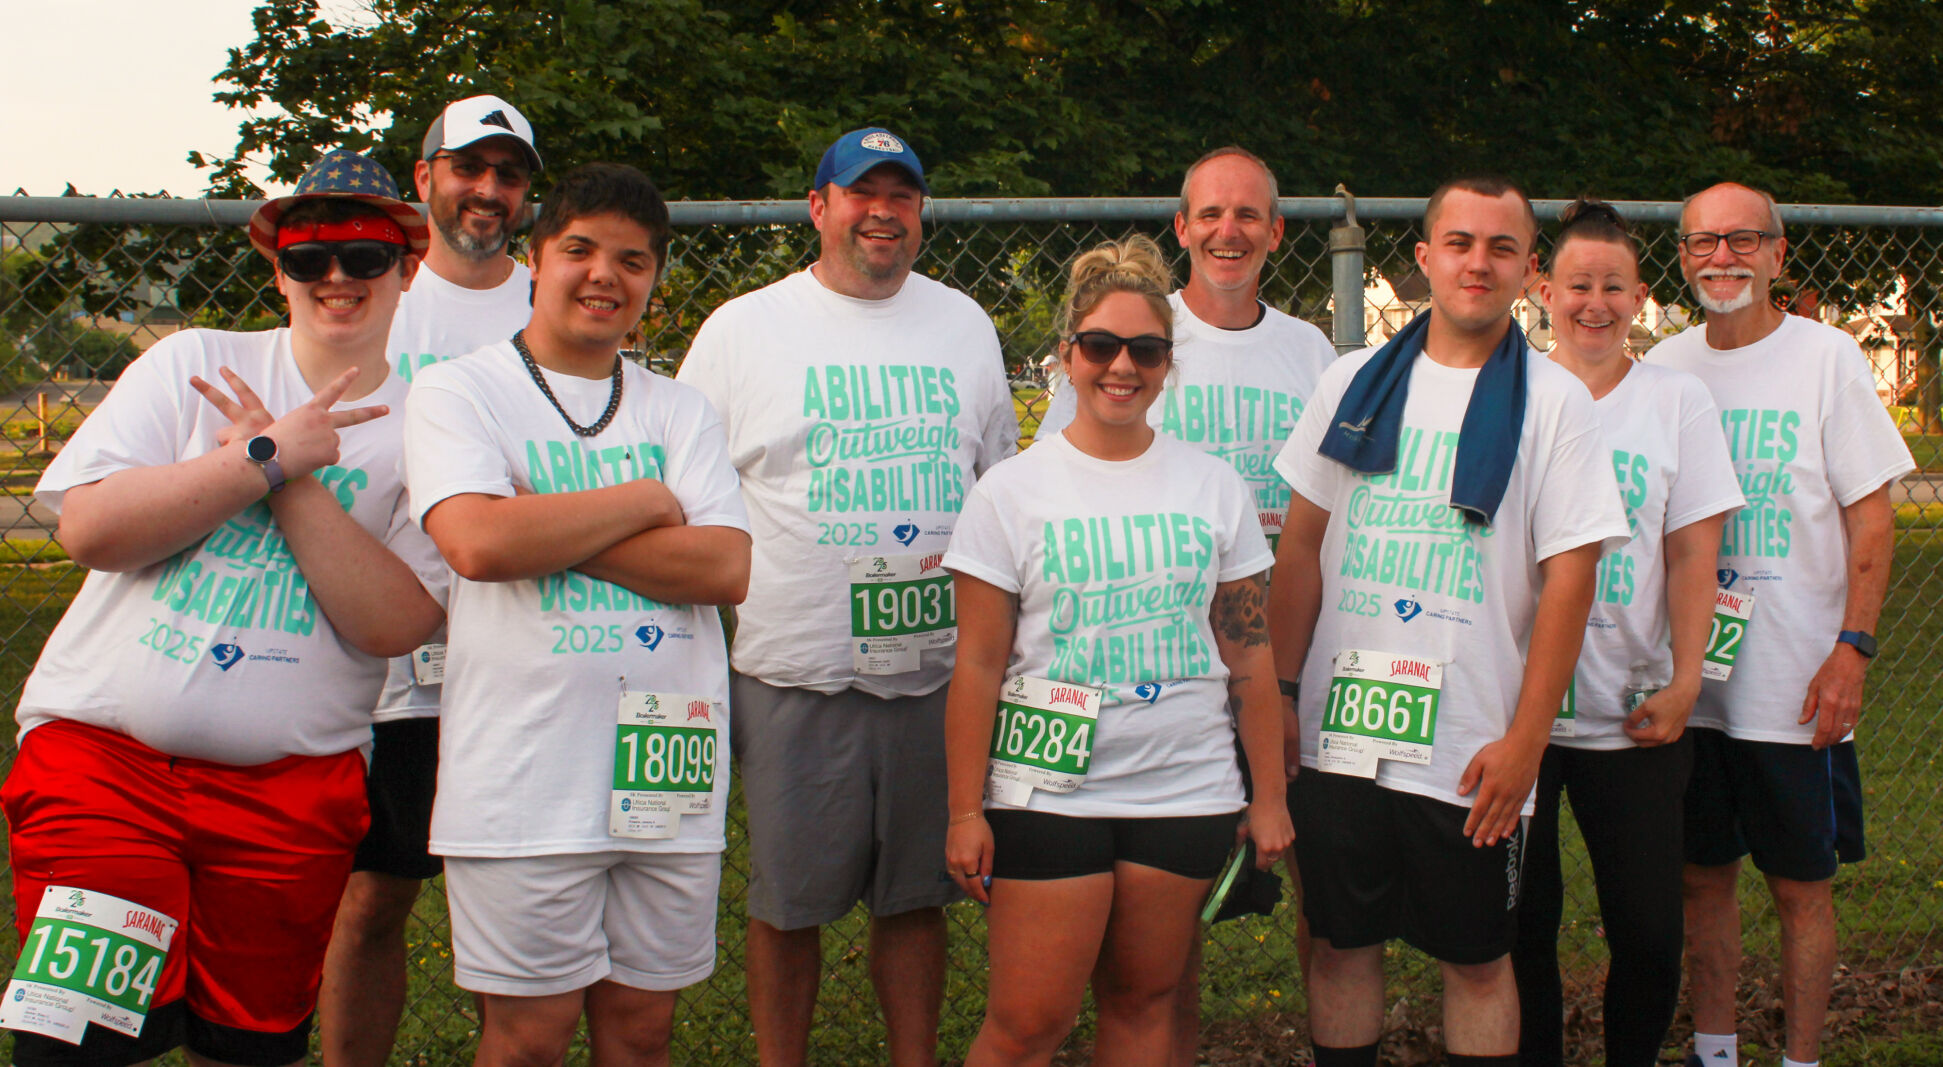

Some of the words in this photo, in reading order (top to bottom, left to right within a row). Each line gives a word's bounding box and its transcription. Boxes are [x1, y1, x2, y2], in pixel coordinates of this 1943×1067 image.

[803, 365, 961, 421] ABILITIES
[806, 416, 961, 468] Outweigh
[808, 461, 964, 514] DISABILITIES
[817, 522, 879, 546] 2025
[1043, 512, 1213, 584] ABILITIES
[1340, 531, 1485, 604] DISABILITIES
[152, 553, 317, 637] DISABILITIES
[855, 580, 956, 631] 19031
[1049, 568, 1208, 635] Outweigh
[1338, 588, 1383, 618] 2025
[138, 617, 205, 665] 2025
[551, 624, 624, 654] 2025
[1048, 621, 1211, 685] DISABILITIES
[1389, 659, 1431, 682] SARANAC
[687, 700, 711, 722] SARANAC
[1048, 687, 1089, 711] SARANAC
[1329, 682, 1433, 738] 18661
[621, 732, 716, 784] 18099
[995, 708, 1091, 768] 16284
[1505, 830, 1520, 911] Reebok
[122, 910, 167, 942] SARANAC
[28, 924, 161, 1006] 15184
